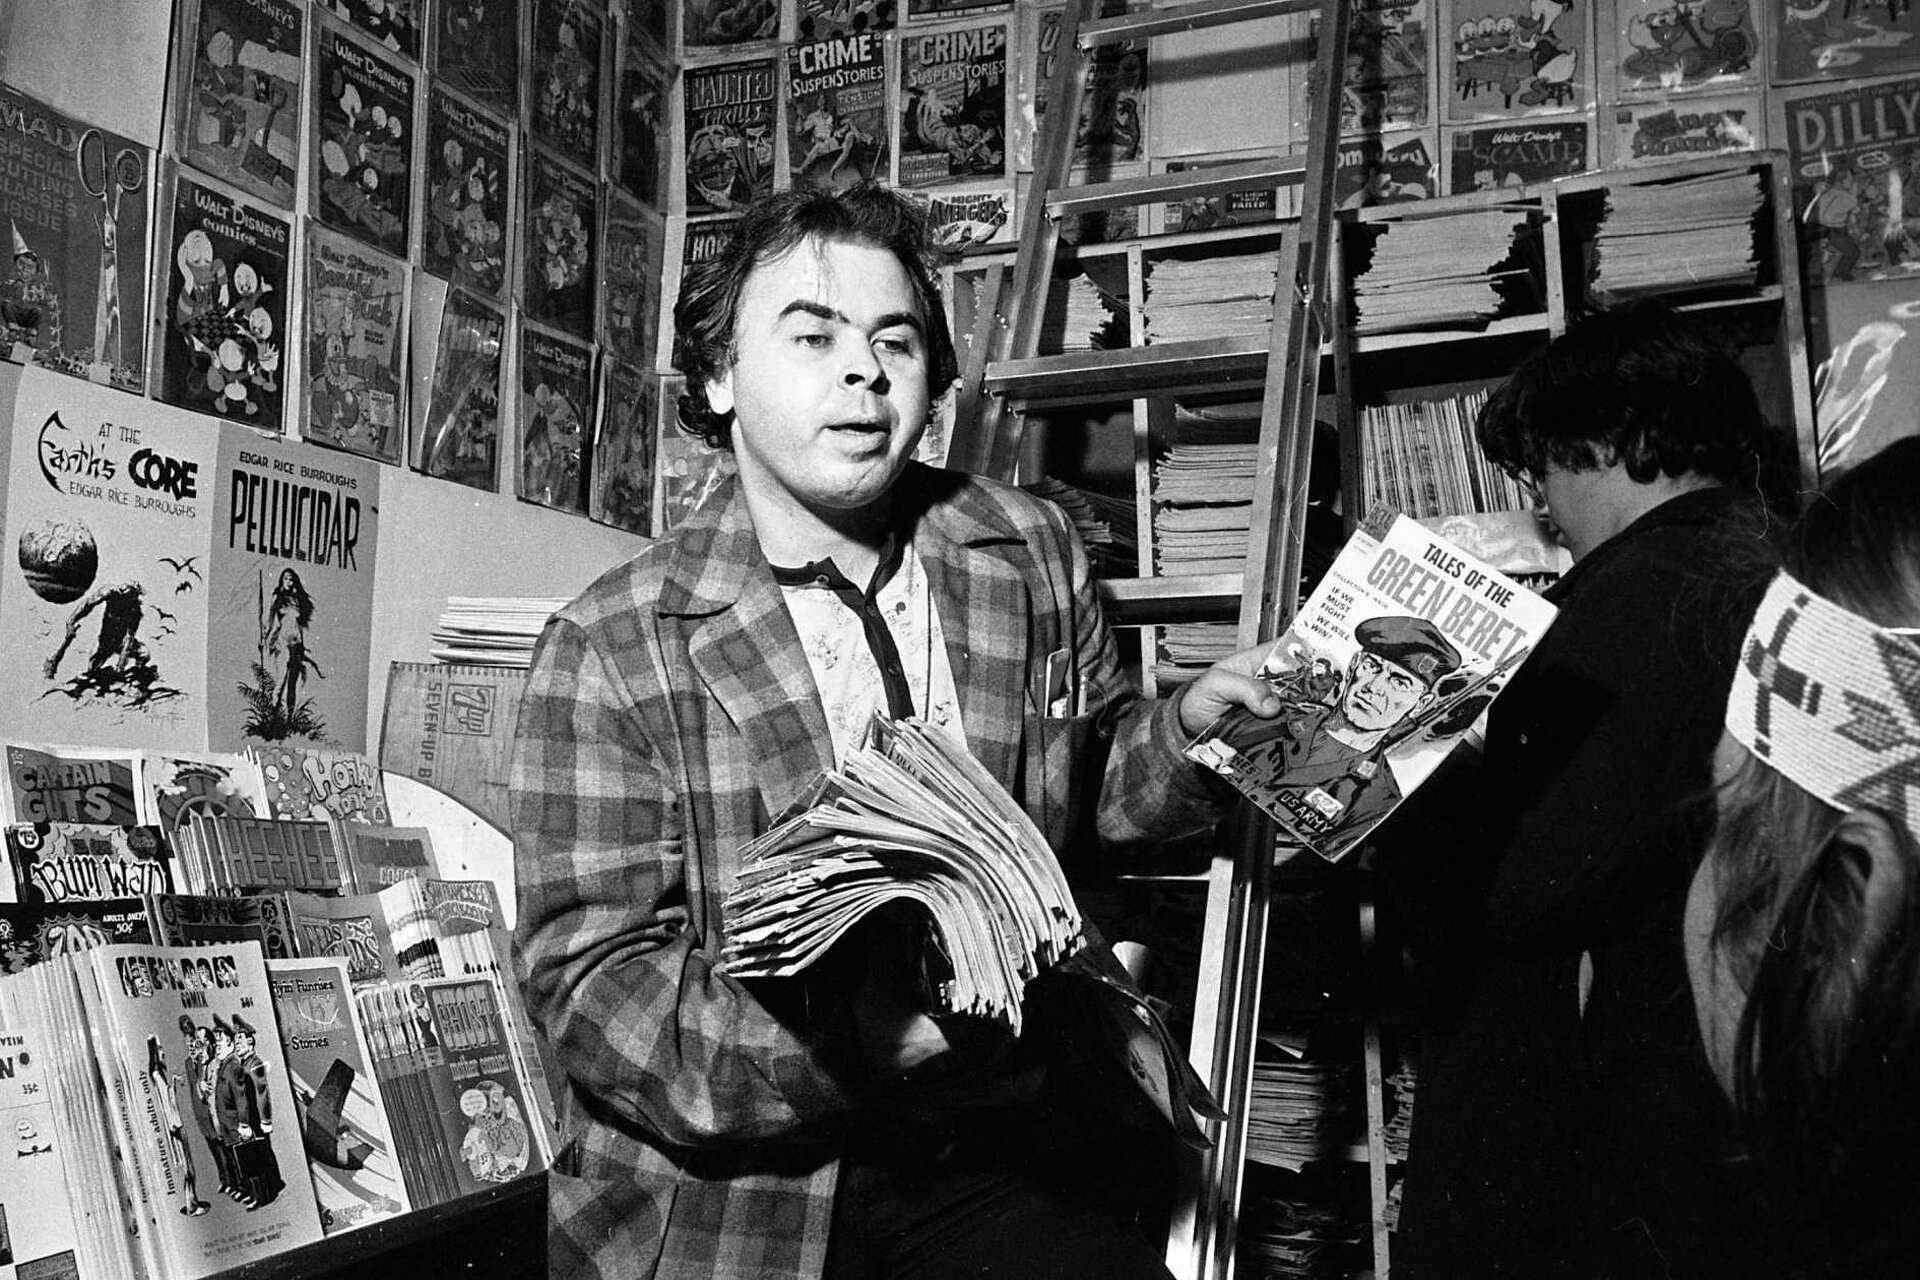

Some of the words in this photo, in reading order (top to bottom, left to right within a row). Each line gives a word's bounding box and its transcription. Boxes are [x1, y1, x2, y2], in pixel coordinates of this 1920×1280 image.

[800, 34, 872, 74] CRIME
[919, 28, 996, 65] CRIME
[792, 65, 884, 97] SUSPENSTORIES
[1796, 91, 1920, 153] DILLY
[1473, 142, 1583, 166] SCAMP
[195, 189, 230, 220] WALT
[231, 201, 286, 243] DISNEY'S
[98, 422, 115, 440] AT
[119, 427, 141, 446] THE
[128, 447, 199, 501] CORE
[239, 450, 269, 468] EDGAR
[273, 459, 296, 476] RICE
[300, 466, 358, 490] BURROUGHS
[69, 481, 103, 501] EDGAR
[107, 487, 130, 506] RICE
[135, 495, 197, 519] BURROUGHS
[229, 468, 362, 573] PELLUCIDAR
[1422, 543, 1466, 579] TALES
[1464, 569, 1488, 591] OF
[1484, 580, 1516, 608] THE
[1327, 594, 1351, 612] MUST
[1366, 548, 1455, 621] GREEN
[1440, 593, 1529, 667] BERET
[420, 682, 443, 762] SEVEN-UP
[15, 760, 112, 791] CAPTAIN
[21, 785, 113, 824] GUTS
[1294, 805, 1334, 834] ARMY
[295, 976, 335, 993] Funnies
[291, 1034, 330, 1051] Stories
[138, 1069, 152, 1095] only
[146, 1098, 161, 1134] adults
[156, 1137, 177, 1196] Immature
